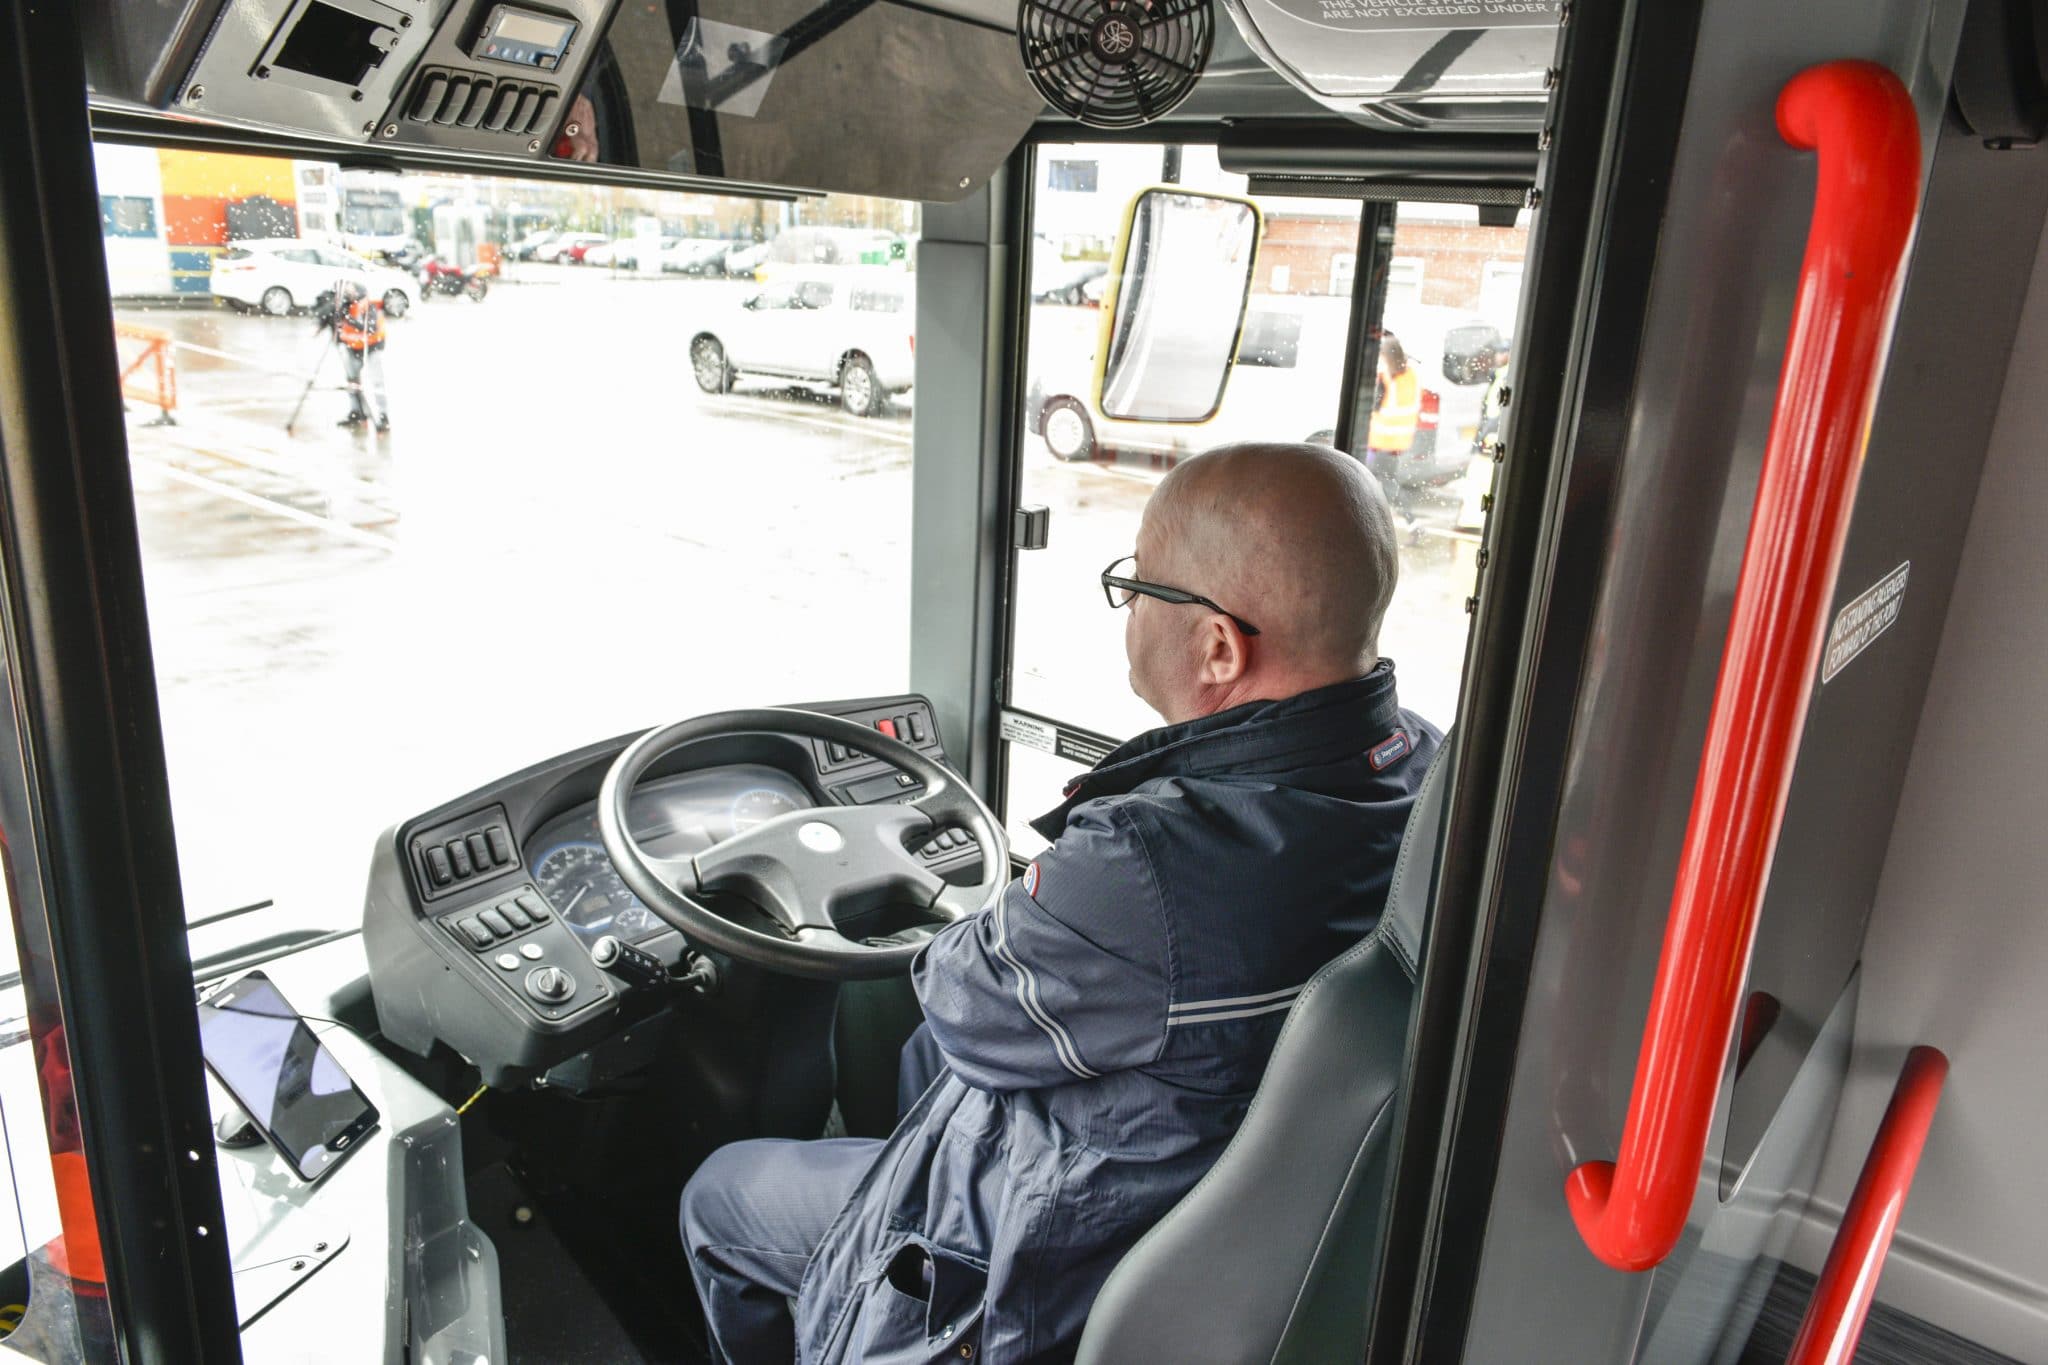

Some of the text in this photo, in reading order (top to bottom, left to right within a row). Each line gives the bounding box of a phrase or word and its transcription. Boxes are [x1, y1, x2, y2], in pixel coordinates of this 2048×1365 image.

[1321, 0, 1356, 9] THIS
[1360, 0, 1440, 8] VEHICLES
[1323, 3, 1550, 19] ARE NOT EXCEEDED UNDER
[1013, 718, 1044, 732] WARNING
